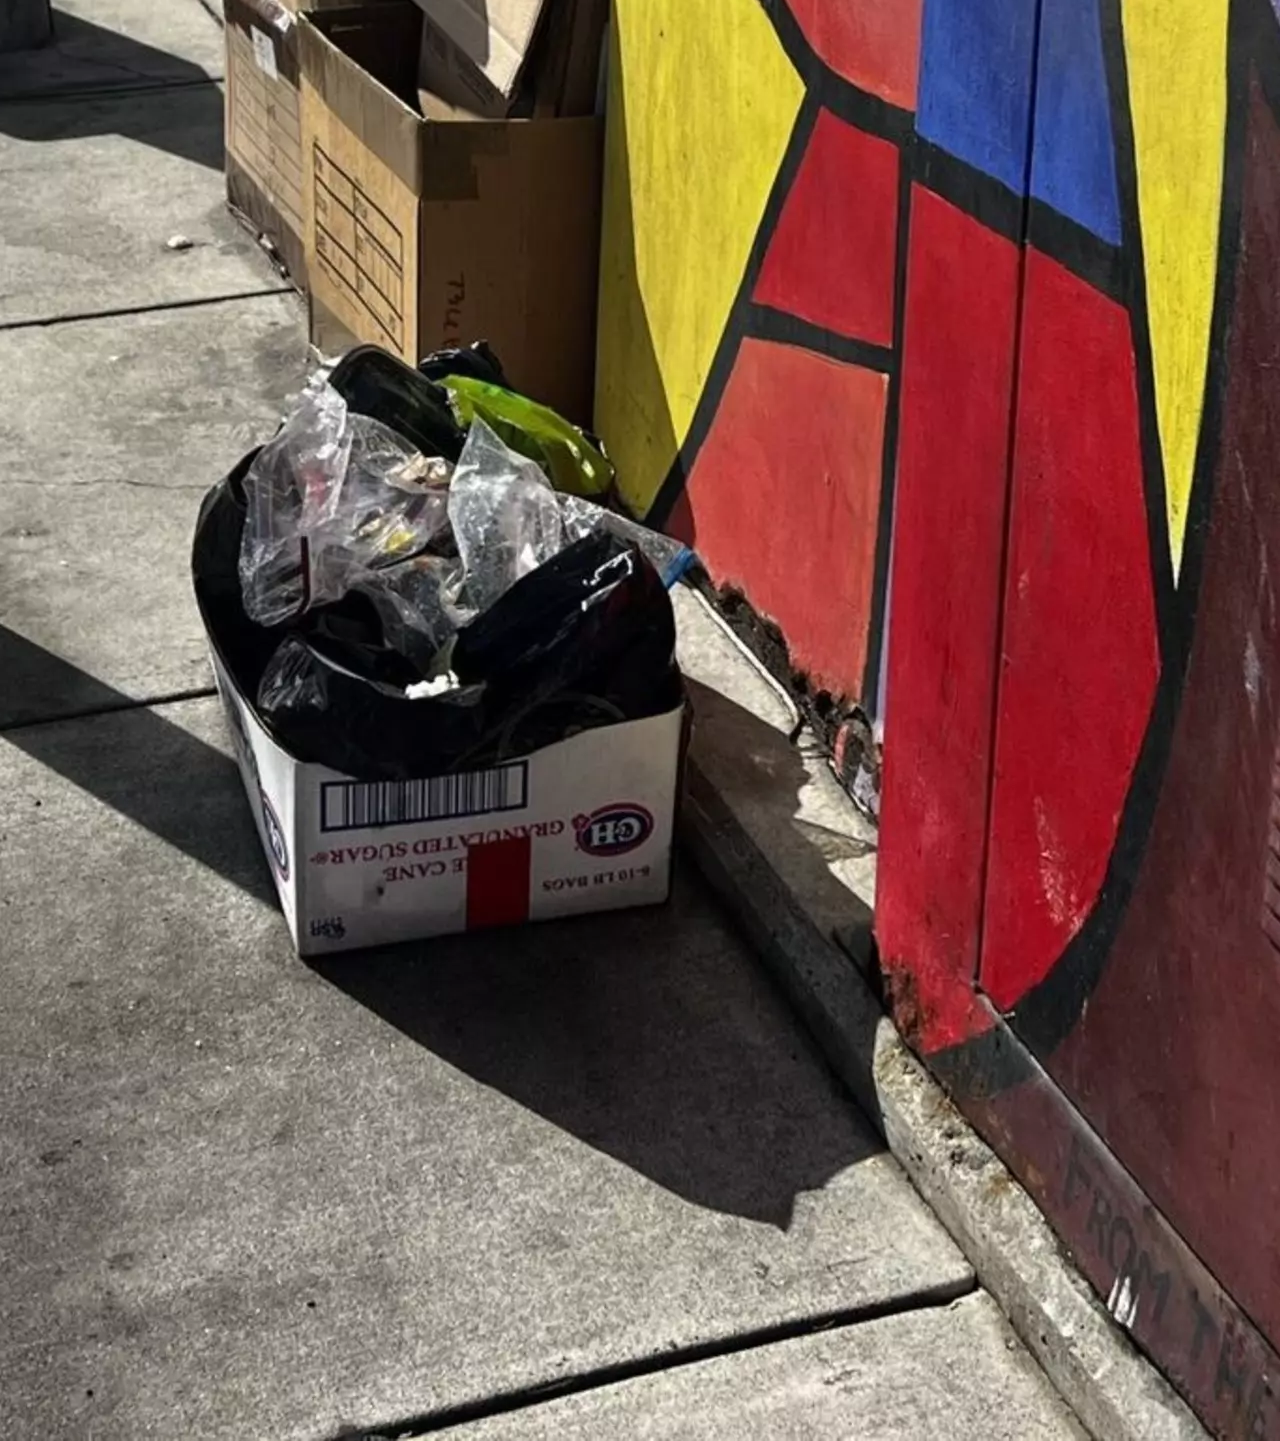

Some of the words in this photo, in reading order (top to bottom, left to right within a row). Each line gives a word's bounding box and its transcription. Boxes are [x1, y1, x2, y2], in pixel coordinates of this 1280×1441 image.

[412, 819, 566, 856] GRANULATED
[330, 841, 409, 864] SUGAR
[383, 860, 447, 883] CANE
[542, 872, 589, 892] BAGS
[593, 870, 616, 885] LB
